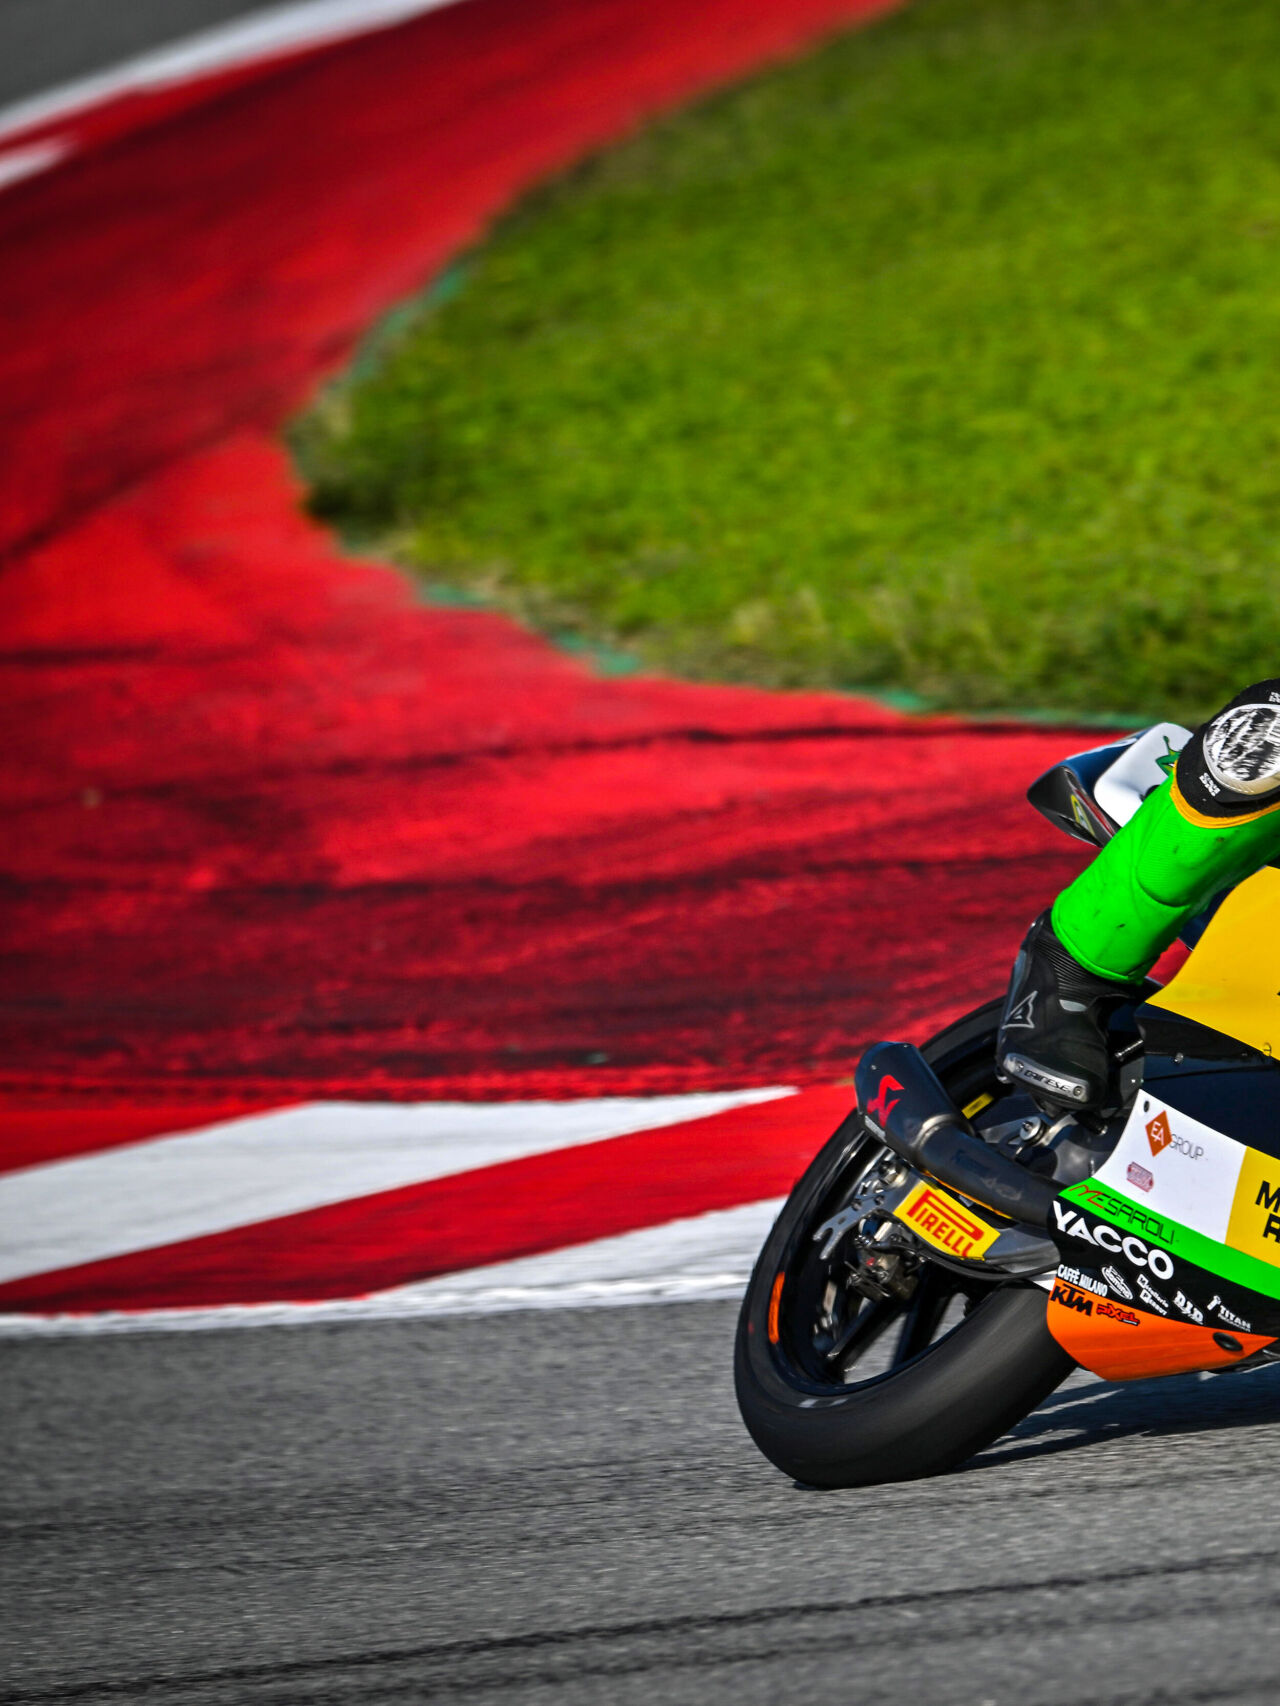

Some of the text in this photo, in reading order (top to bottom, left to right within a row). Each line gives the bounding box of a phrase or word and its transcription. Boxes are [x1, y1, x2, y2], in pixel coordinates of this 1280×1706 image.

[1168, 1133, 1204, 1160] GROUP
[1053, 1200, 1174, 1280] YACCO
[1078, 1273, 1108, 1297] MILANO
[1050, 1283, 1093, 1317] KTM
[1220, 1305, 1251, 1329] TITAN
